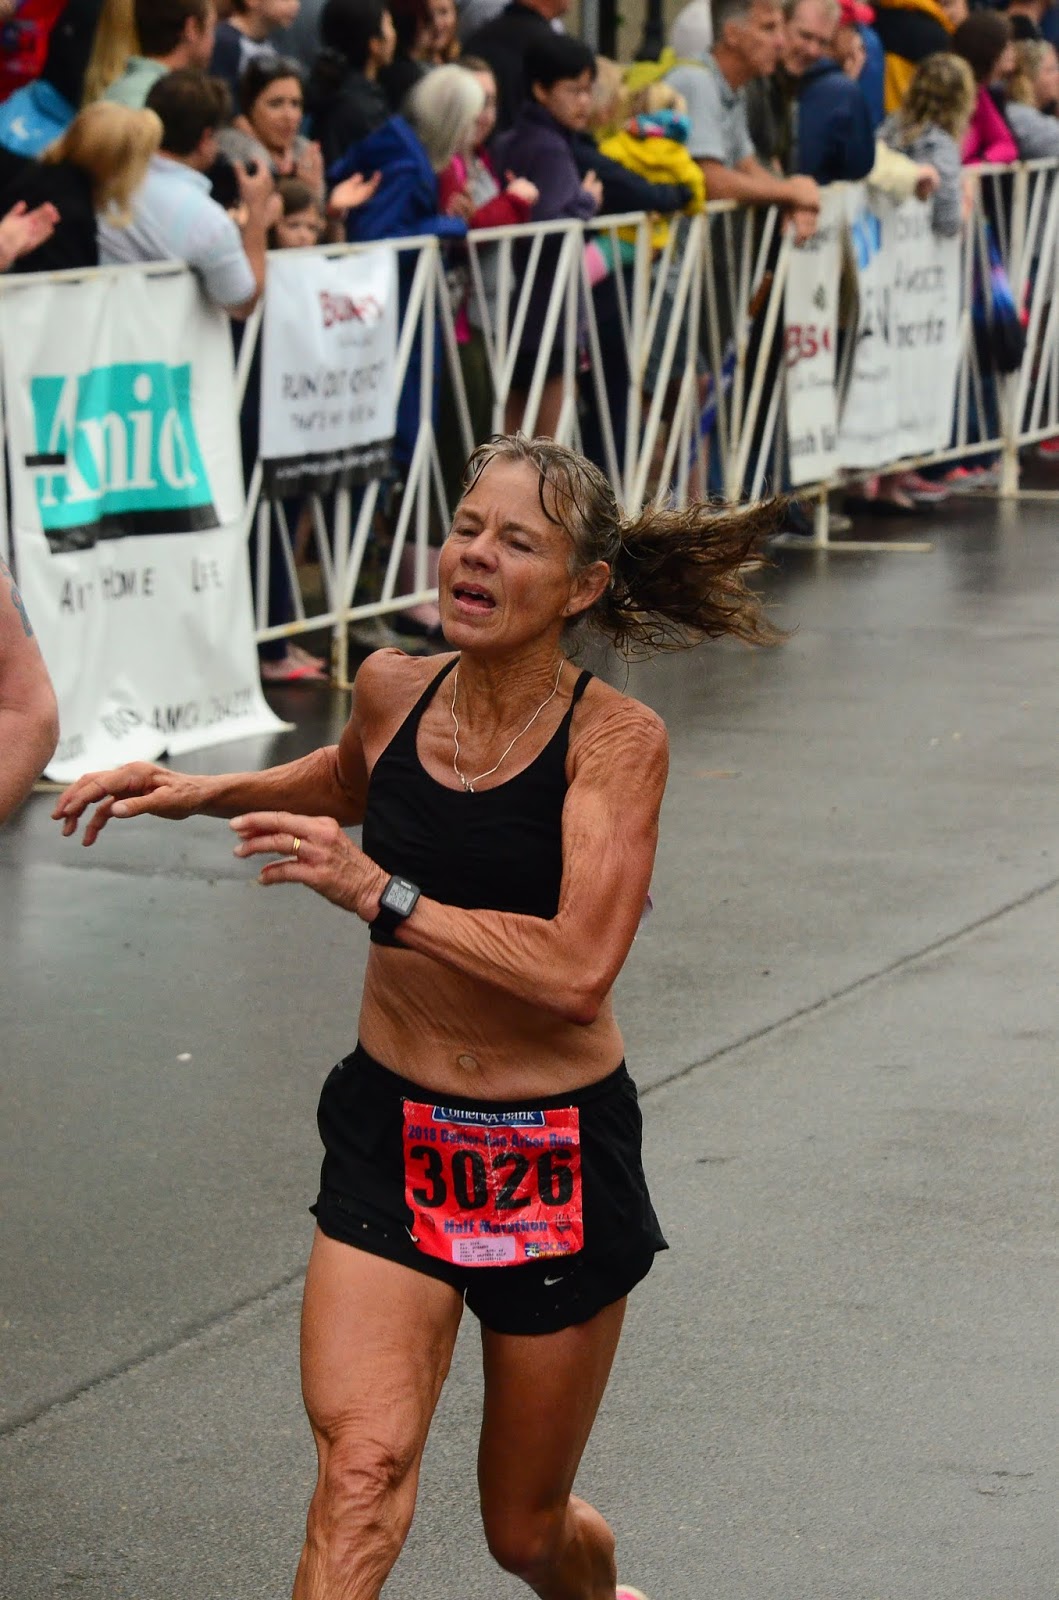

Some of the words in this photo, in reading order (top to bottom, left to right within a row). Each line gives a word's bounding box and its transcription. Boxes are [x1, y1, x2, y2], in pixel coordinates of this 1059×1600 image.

[407, 1125, 437, 1143] 2018
[511, 1132, 546, 1148] Arbor
[548, 1132, 573, 1147] Run
[410, 1145, 574, 1211] 3026
[444, 1218, 475, 1234] Half
[479, 1219, 548, 1234] Marathon
